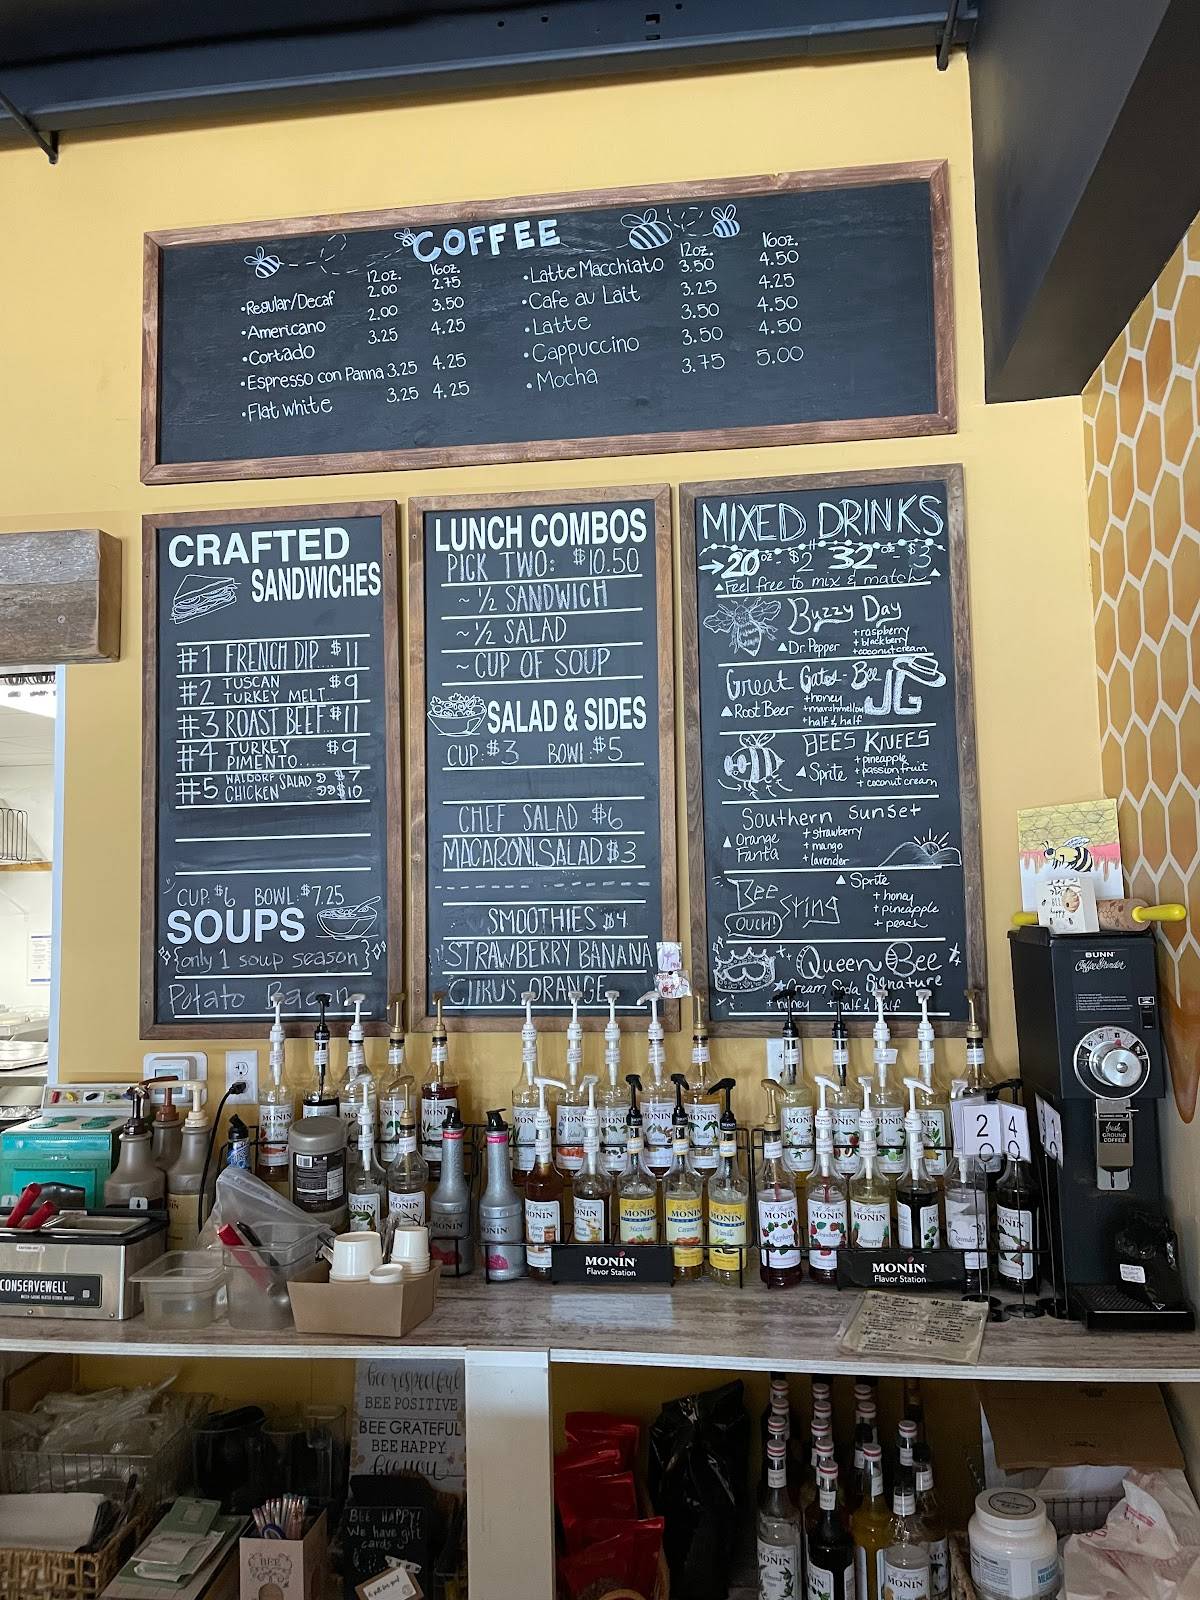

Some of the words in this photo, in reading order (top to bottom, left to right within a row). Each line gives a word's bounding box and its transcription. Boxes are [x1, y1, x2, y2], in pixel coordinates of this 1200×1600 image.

[412, 219, 561, 262] COFFEE
[530, 267, 576, 283] Latte
[580, 257, 664, 279] Macchiato
[680, 258, 715, 273] 3.50
[759, 250, 799, 266] 4.50
[247, 291, 336, 315] Regular/Decaf
[368, 284, 398, 298] 2.00
[431, 277, 461, 290] 2.75
[529, 292, 569, 310] Cafe
[575, 293, 595, 305] au
[603, 285, 641, 305] Lait
[681, 280, 718, 296] 3.25
[759, 274, 795, 289] 4.25
[248, 320, 326, 339] Americano
[368, 306, 398, 321] 2.00
[431, 297, 464, 312] 3.50
[533, 315, 592, 336] Latte
[681, 304, 719, 320] 3.50
[757, 296, 798, 312] 4.50
[248, 344, 315, 366] Cortado
[368, 329, 398, 344] 3.25
[431, 319, 465, 336] 4.25
[532, 335, 640, 363] Cappuccino
[682, 327, 723, 346] 3.50
[759, 317, 801, 335] 4.50
[248, 372, 314, 392] Espresso
[317, 370, 342, 382] con
[345, 367, 385, 380] Panna
[387, 361, 418, 378] 3.25
[432, 354, 467, 370] 4.25
[537, 367, 599, 391] Mocha
[682, 354, 726, 374] 3.75
[756, 346, 804, 366] 5.00
[248, 402, 279, 422] Flat
[283, 398, 333, 416] white
[386, 386, 419, 403] 3.25
[432, 381, 469, 399] 4.25
[435, 515, 523, 551] LUNCH
[531, 507, 647, 549] COMBOS
[703, 502, 807, 542] MIXED
[818, 494, 944, 540] DRINKS
[168, 527, 350, 567] CRAFTED
[789, 551, 814, 572] $2
[828, 545, 878, 570] 32
[908, 544, 931, 568] $3
[447, 553, 488, 582] PICK
[499, 551, 555, 579] TWO:
[573, 548, 640, 575] $10.50
[251, 562, 381, 602] SANDWICHES
[725, 580, 749, 593] Feel
[756, 577, 786, 591] free
[789, 574, 804, 589] to
[812, 571, 841, 587] mix
[864, 568, 928, 584] match
[505, 580, 608, 612] SANDWICH
[787, 598, 853, 635] Buzzy
[862, 595, 902, 628] Day
[504, 616, 567, 644] SALAD
[177, 645, 210, 673] #1
[225, 641, 287, 672] FRENCH
[808, 638, 840, 657] Pepper
[475, 652, 510, 679] CUP
[520, 650, 544, 679] OF
[555, 648, 611, 676] SOUP
[179, 679, 215, 706] #2
[223, 675, 280, 689] TUSCAN
[223, 690, 280, 704] TURKEY
[329, 674, 358, 700] $9
[726, 669, 794, 701] Great
[177, 711, 220, 739] #3
[225, 708, 279, 738] ROAST
[329, 705, 358, 733] $11
[487, 700, 557, 734] SALAD
[564, 700, 578, 731] &
[584, 696, 647, 731] SIDES
[734, 704, 761, 718] Root
[764, 701, 794, 717] Beer
[841, 715, 862, 725] half
[177, 741, 218, 772] #4
[225, 740, 290, 755] TURKEY
[327, 740, 357, 765] $9
[486, 739, 520, 765] $3
[592, 736, 623, 762] $5
[802, 732, 856, 757] BEES
[865, 730, 930, 753] KNEES
[809, 762, 848, 785] Sprite
[176, 777, 218, 804] #5
[279, 773, 312, 790] SALAD
[225, 784, 279, 802] CHICKEN
[459, 804, 506, 833] CHEF
[523, 803, 578, 832] SALAD
[590, 803, 623, 830] $6
[742, 808, 833, 831] Southern
[848, 804, 921, 821] Sunset
[535, 837, 603, 868] SALAD
[606, 840, 637, 863] $3
[736, 833, 780, 849] Orange
[737, 849, 779, 863] Fanta
[851, 872, 890, 888] Sprite
[214, 885, 236, 907] $6
[254, 887, 300, 906] BOWL:
[301, 885, 345, 906] $7.25
[884, 891, 914, 904] honey
[167, 907, 305, 944] SOUPS
[487, 906, 597, 934] SMOOTHIES
[735, 917, 777, 931] OUCH!
[219, 949, 230, 969] 1
[239, 954, 284, 971] soup
[446, 940, 572, 971] STRAWBERRY
[578, 941, 654, 969] BANANA
[796, 945, 882, 979] Queen
[886, 943, 942, 977] Bee
[529, 975, 608, 1004] ORANGE
[866, 974, 942, 992] Signature
[168, 983, 246, 1015] Potato
[976, 1114, 988, 1137] 2
[1008, 1116, 1017, 1138] 4
[765, 1210, 795, 1219] MONIN
[812, 1211, 844, 1219] MONIN
[854, 1212, 885, 1221] MONIN
[585, 1255, 635, 1267] MONIN
[587, 1268, 609, 1276] Flavor
[611, 1268, 636, 1277] Station
[872, 1263, 925, 1274] MONIN
[0, 1279, 67, 1293] CONSERVEWELL
[875, 1275, 898, 1283] Flavor
[900, 1275, 926, 1283] Station
[365, 1397, 391, 1408] BEE
[395, 1397, 458, 1411] POSITIVE
[360, 1421, 386, 1434] BEE
[389, 1421, 461, 1436] GRATEFUL
[372, 1440, 398, 1452] BEE
[400, 1441, 447, 1454] HAPPY
[887, 1575, 923, 1588] MONIN
